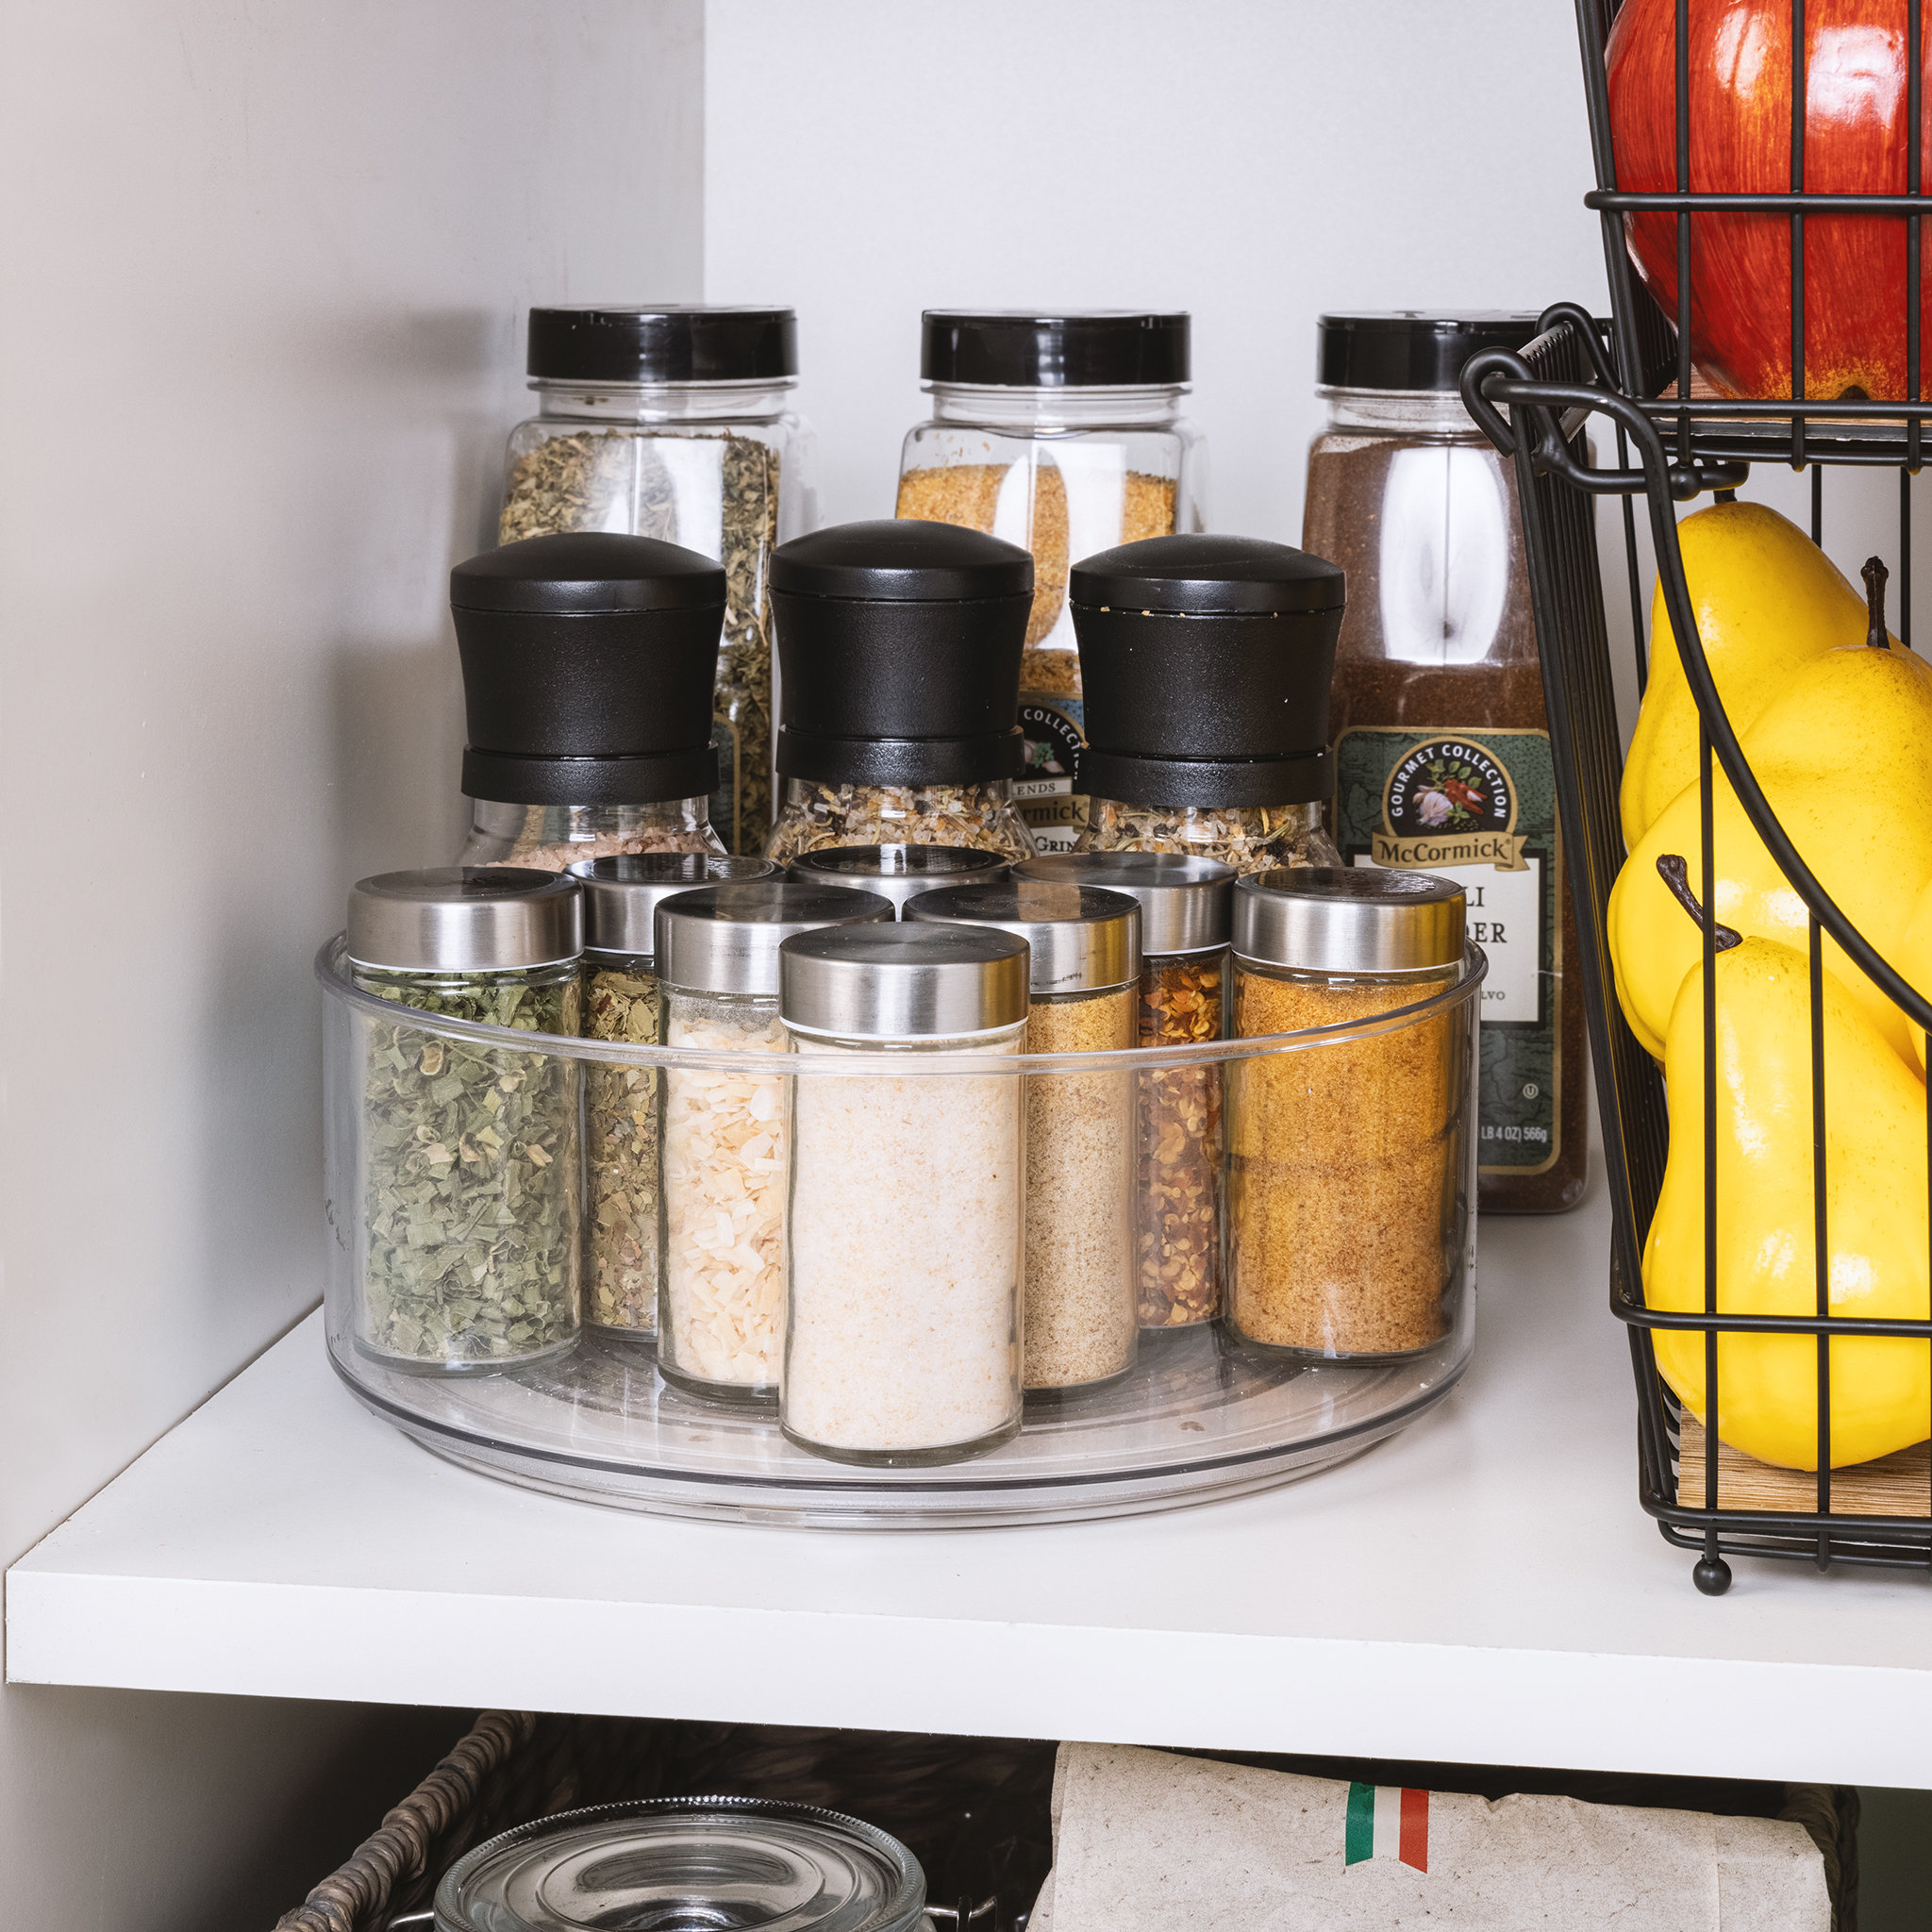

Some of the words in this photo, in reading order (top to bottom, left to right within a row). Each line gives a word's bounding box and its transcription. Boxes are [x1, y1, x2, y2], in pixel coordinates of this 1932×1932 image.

[1012, 783, 1056, 795] ENDS
[1391, 746, 1435, 818] GOURMET
[1441, 743, 1507, 819] COLLECTION
[1023, 801, 1086, 823] rmick
[1035, 836, 1075, 852] GRIN
[1376, 837, 1509, 863] McCormick
[1481, 991, 1506, 1001] LVO
[1481, 1125, 1494, 1140] LB
[1495, 1126, 1503, 1141] 4
[1504, 1126, 1522, 1143] OZ)
[1524, 1126, 1547, 1143] 566g
